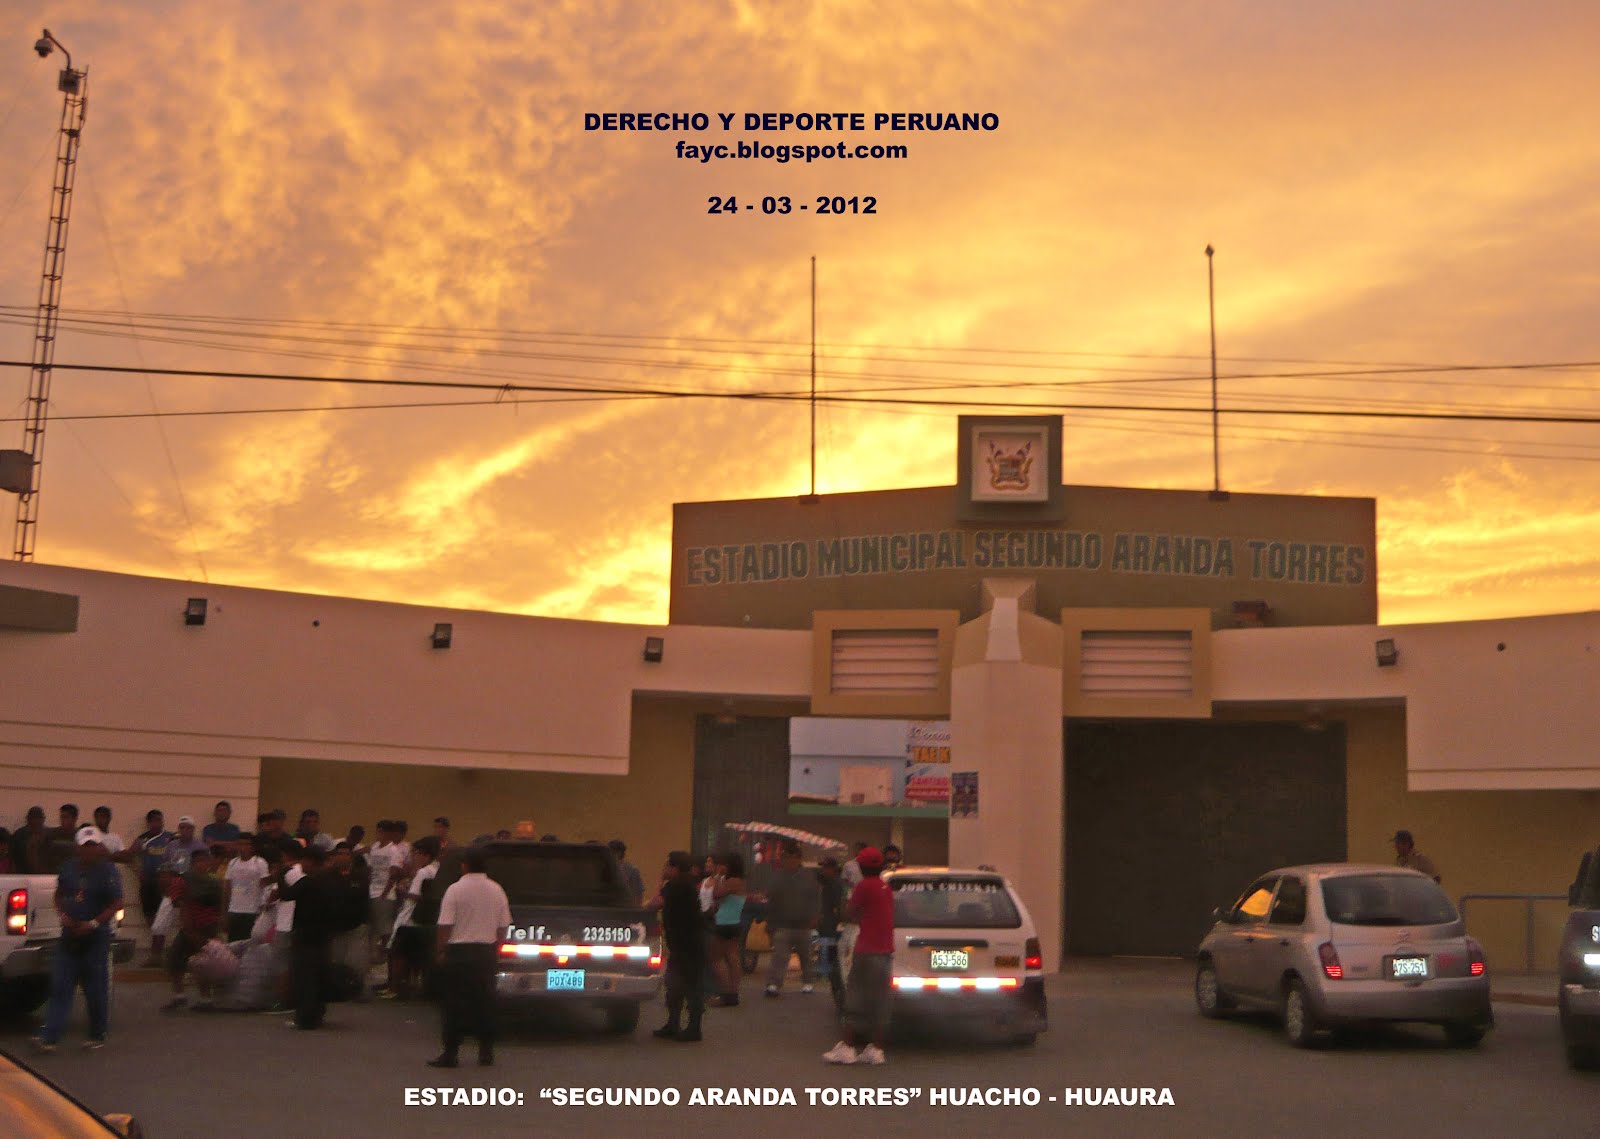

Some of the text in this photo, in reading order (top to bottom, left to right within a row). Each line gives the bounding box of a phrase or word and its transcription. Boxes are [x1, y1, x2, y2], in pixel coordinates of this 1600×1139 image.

[686, 530, 1366, 587] ESTADIO MUNICIPAL SEGUNDO ARANDA TORRES
[506, 924, 632, 942] Telf. 2325150
